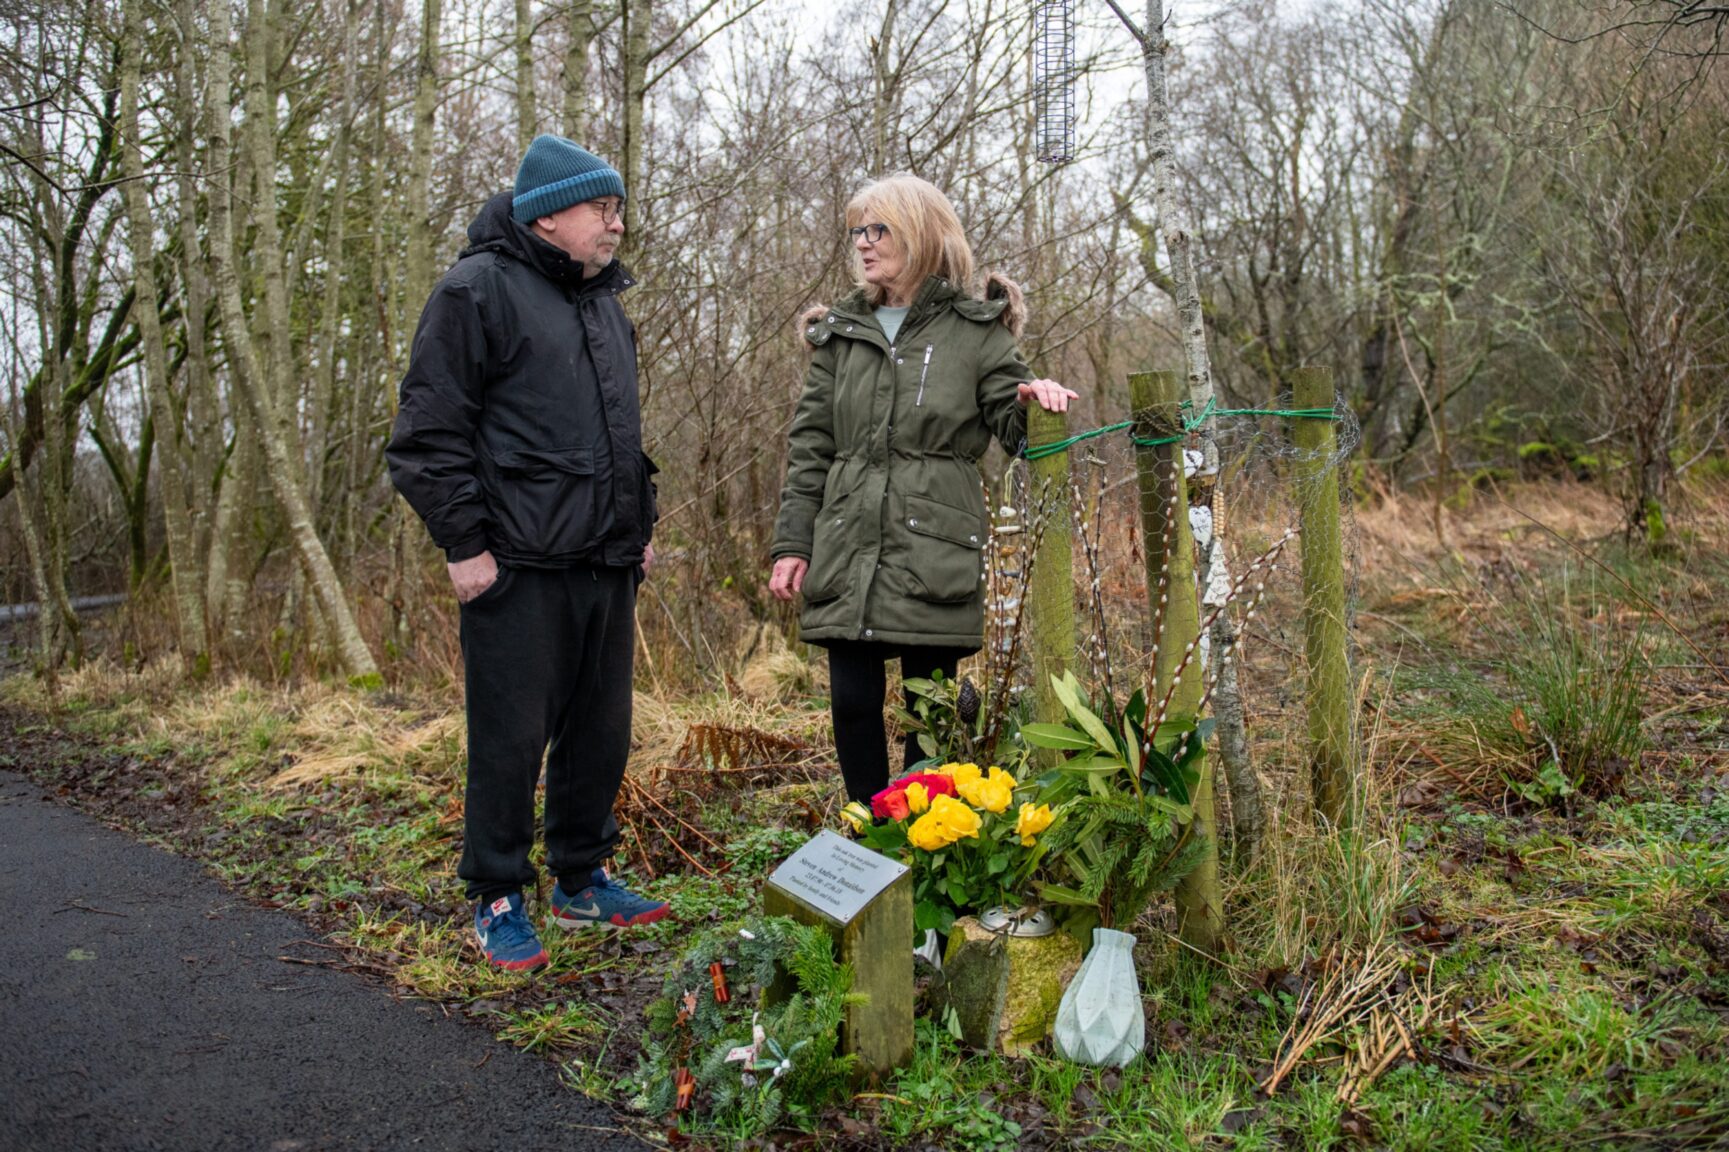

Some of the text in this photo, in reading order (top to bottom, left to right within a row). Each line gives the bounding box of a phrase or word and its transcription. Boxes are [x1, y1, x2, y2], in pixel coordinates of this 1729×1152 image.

[799, 858, 817, 870] Steven
[816, 867, 838, 880] Andrew
[835, 855, 849, 865] Loving
[848, 861, 865, 873] Memory
[861, 860, 879, 869] planted
[789, 876, 804, 885] Planted
